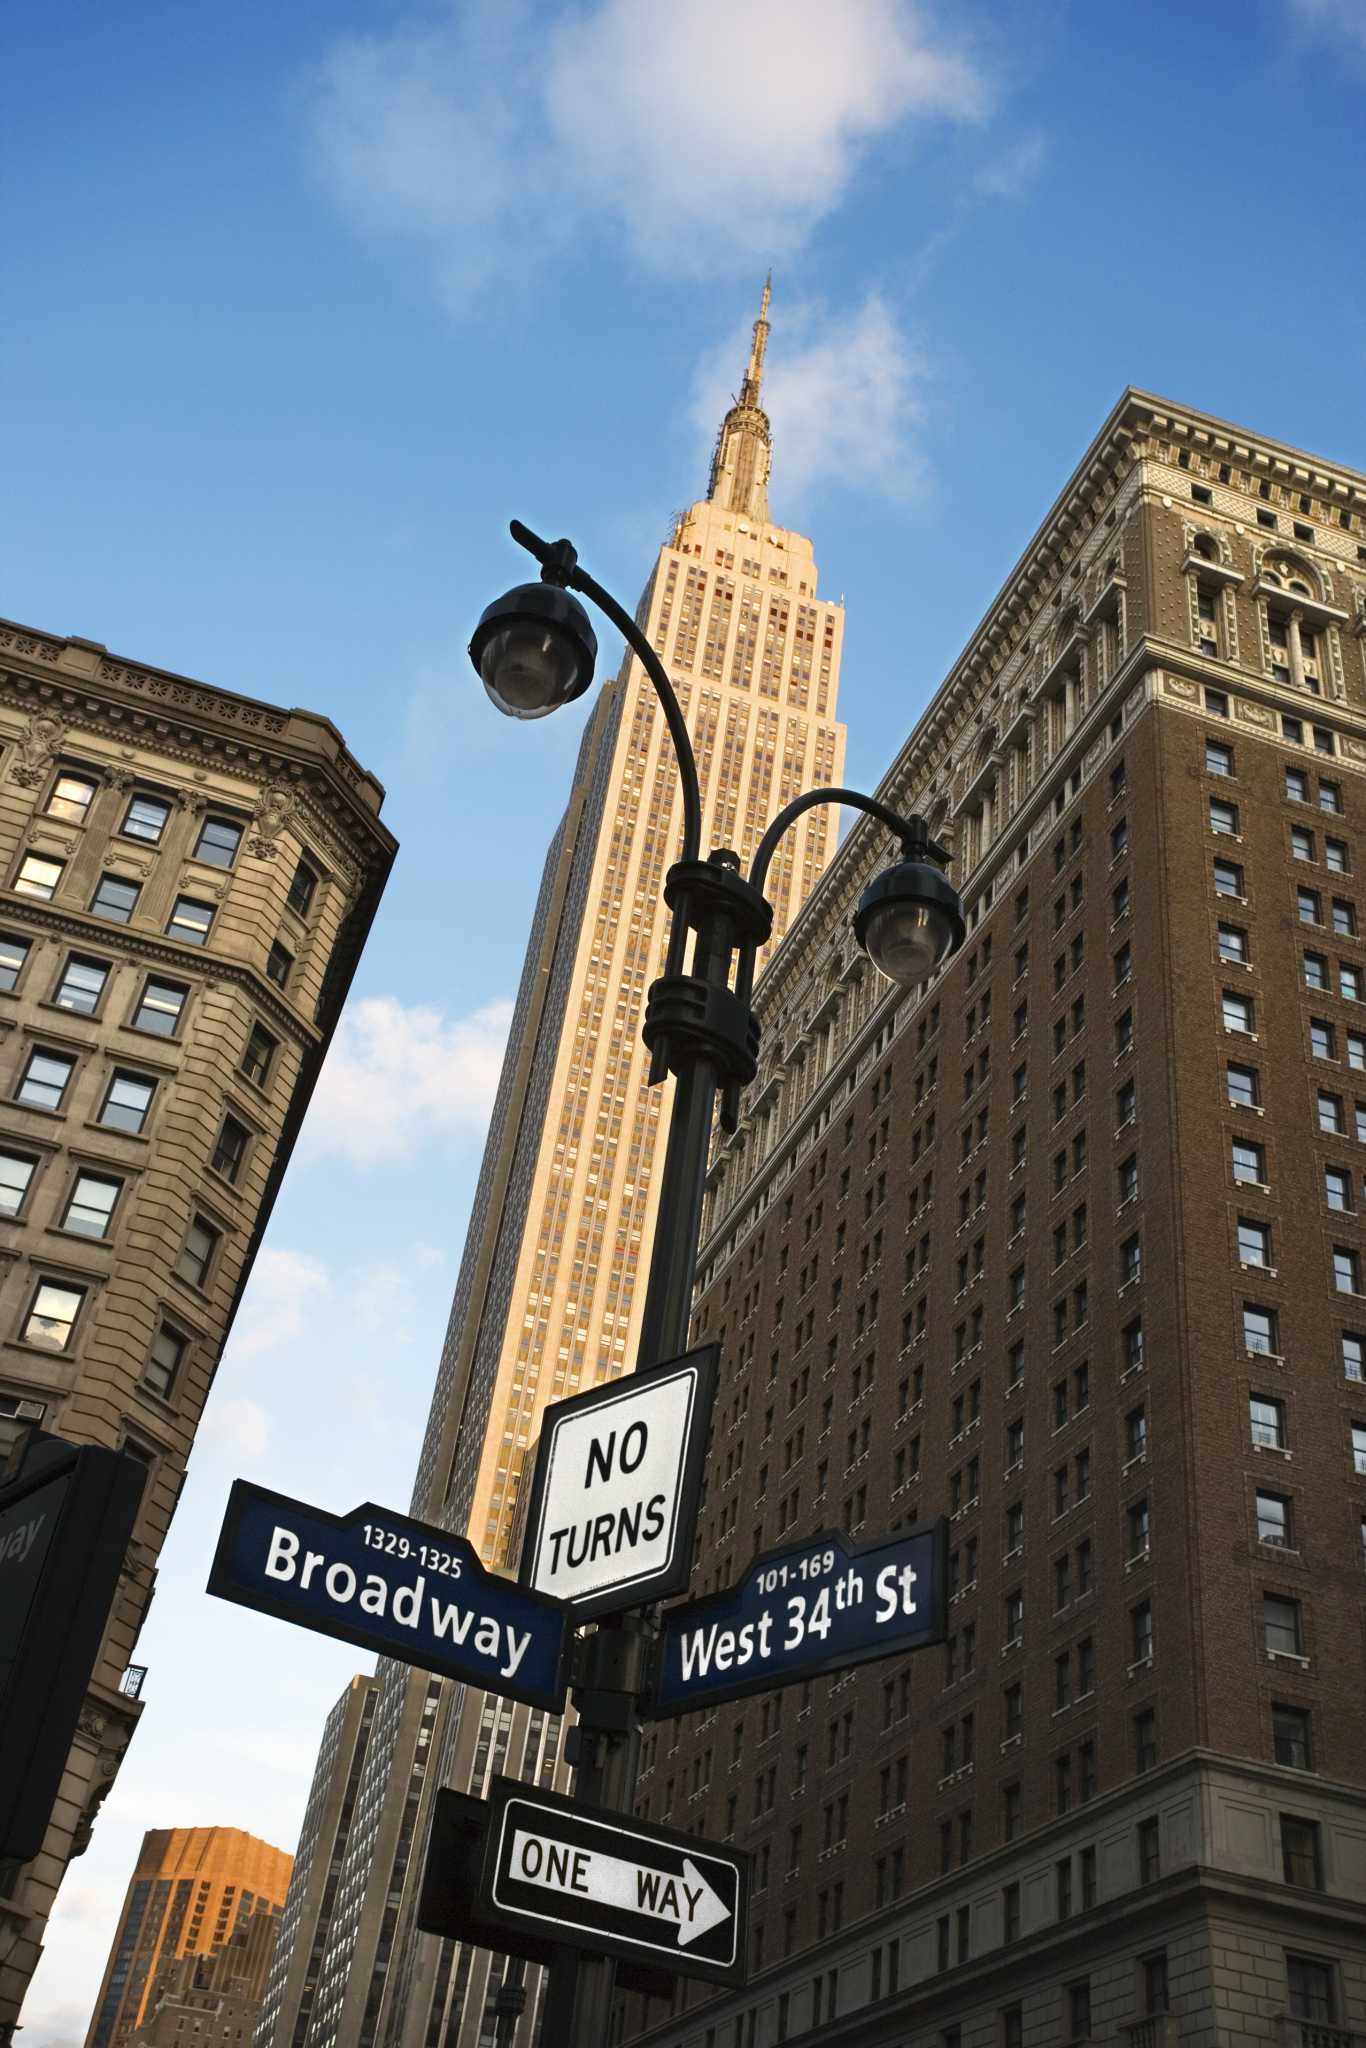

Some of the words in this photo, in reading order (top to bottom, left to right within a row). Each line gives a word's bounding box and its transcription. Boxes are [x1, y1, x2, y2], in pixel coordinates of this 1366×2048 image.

[584, 1421, 648, 1489] NO
[363, 1524, 463, 1579] 1329-1325
[549, 1494, 666, 1575] TURNS
[756, 1550, 834, 1595] 101-169
[264, 1526, 532, 1678] Broadway
[680, 1610, 773, 1681] West
[784, 1568, 863, 1650] 34th
[875, 1564, 917, 1623] St
[521, 1839, 591, 1893] ONE
[637, 1870, 704, 1922] WAY
